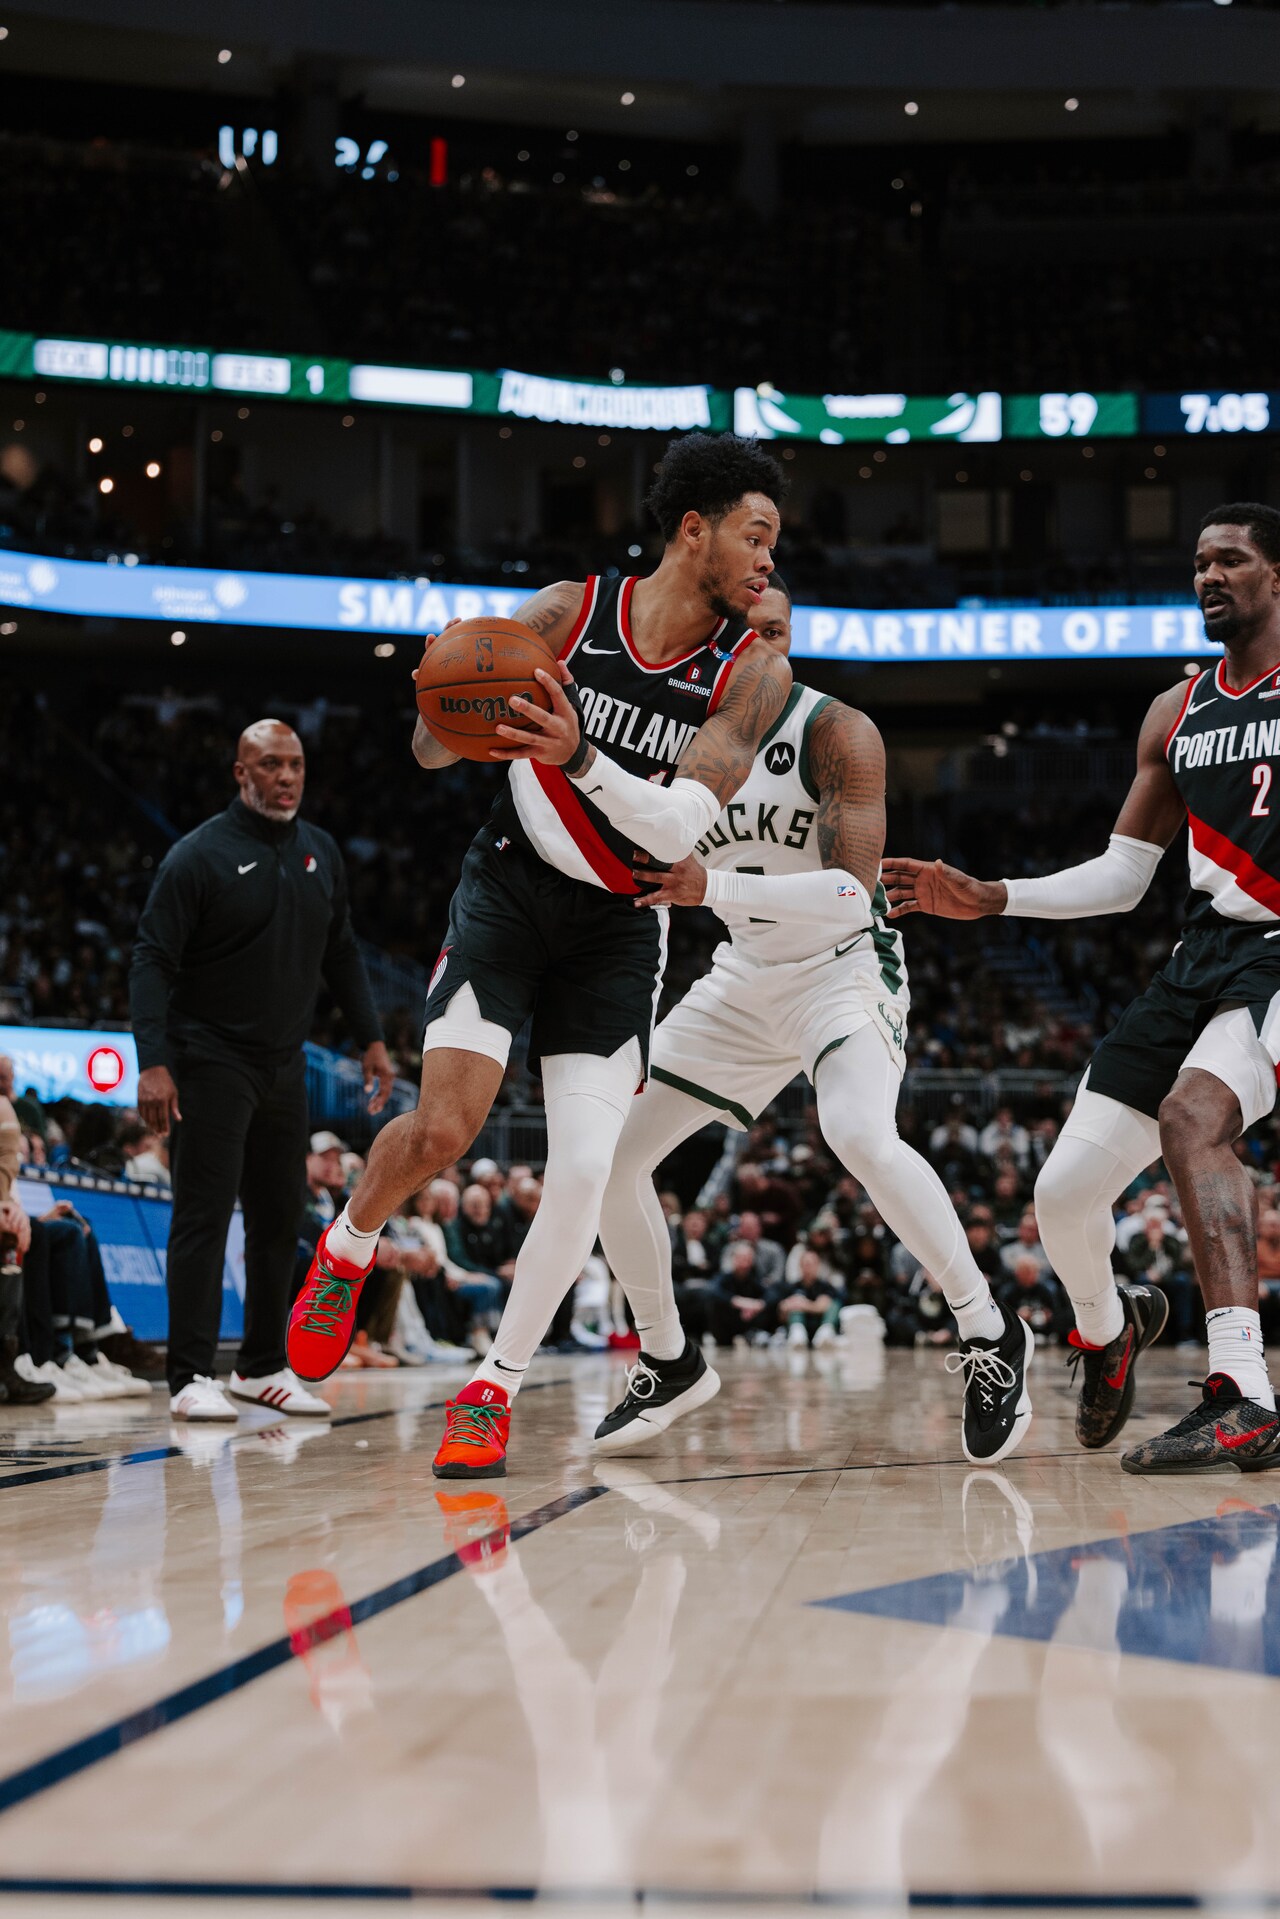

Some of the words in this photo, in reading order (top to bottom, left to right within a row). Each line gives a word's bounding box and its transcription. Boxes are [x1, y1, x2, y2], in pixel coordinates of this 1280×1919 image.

[306, 365, 325, 395] 1
[1039, 392, 1098, 436] 59
[810, 612, 1044, 654] PARTNER
[1062, 611, 1133, 652] OF
[1152, 609, 1225, 651] FI
[667, 677, 712, 697] BRIGHTSIDE
[575, 684, 700, 766] ORTLAN
[1250, 762, 1272, 817] 2
